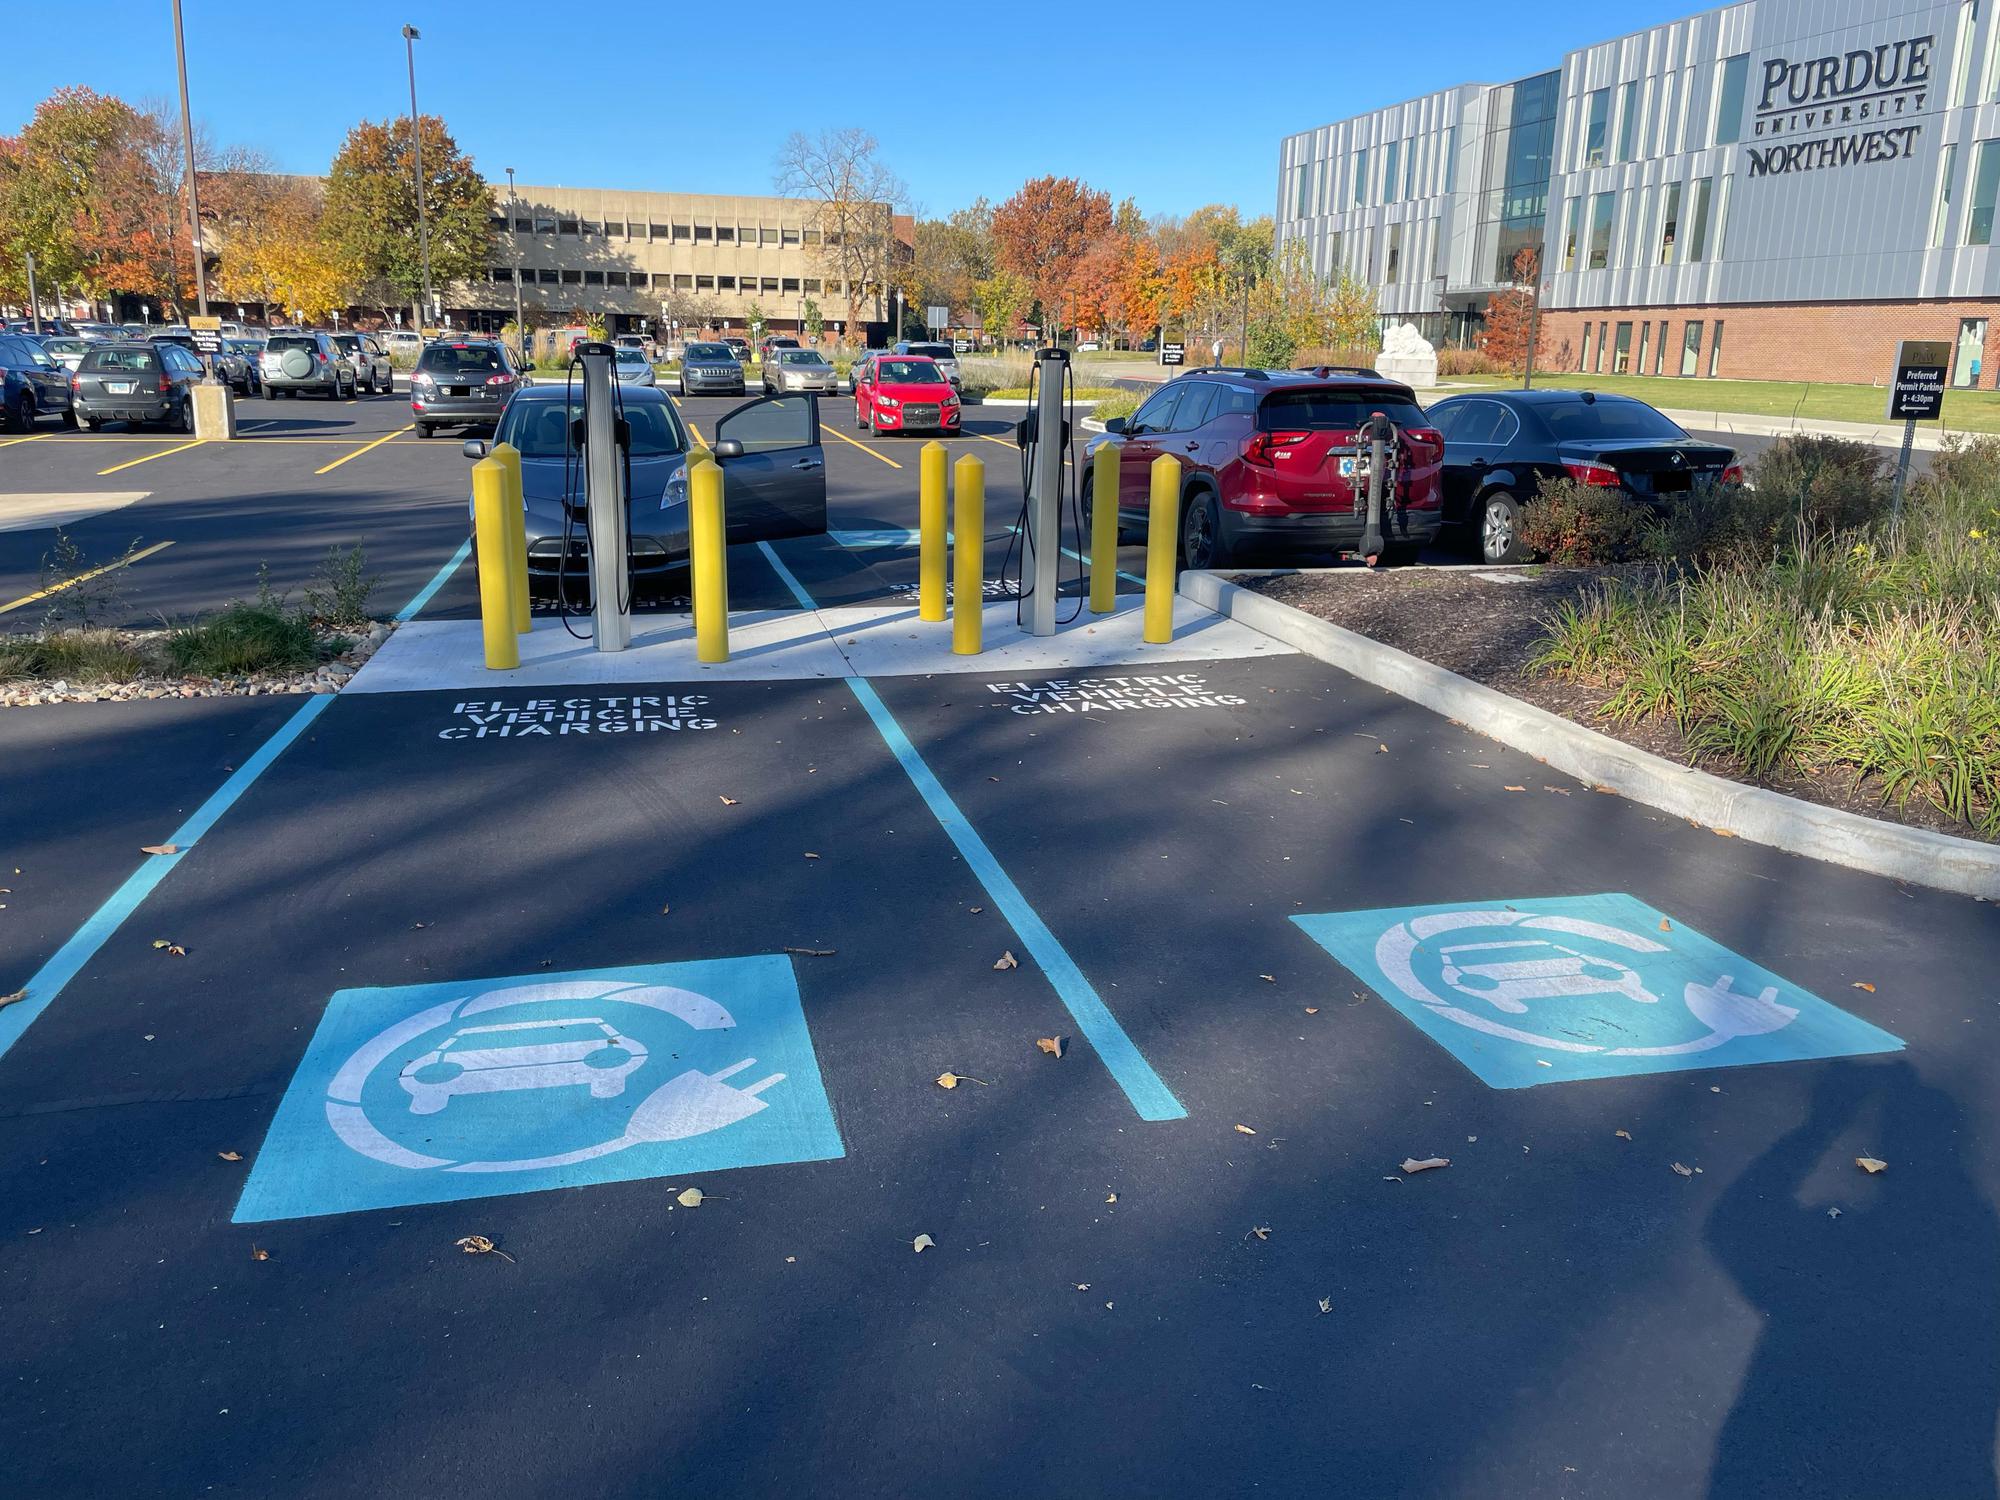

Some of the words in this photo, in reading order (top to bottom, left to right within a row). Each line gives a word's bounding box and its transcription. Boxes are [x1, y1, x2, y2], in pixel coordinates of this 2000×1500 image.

[1757, 34, 1935, 110] PURDUE
[1755, 93, 1926, 135] UNIVERSITY
[1747, 125, 1922, 178] NORTHWEST
[1906, 370, 1938, 380] Preferred
[1896, 382, 1918, 390] Permit
[1919, 382, 1944, 393] Parking
[986, 674, 1207, 693] ELECTRIC
[1011, 684, 1215, 703] VEHICLE
[453, 695, 710, 714] ELECTRIC
[1010, 694, 1248, 715] CHARGING
[467, 706, 698, 724] VEHICLE
[438, 718, 718, 740] CHARGING
